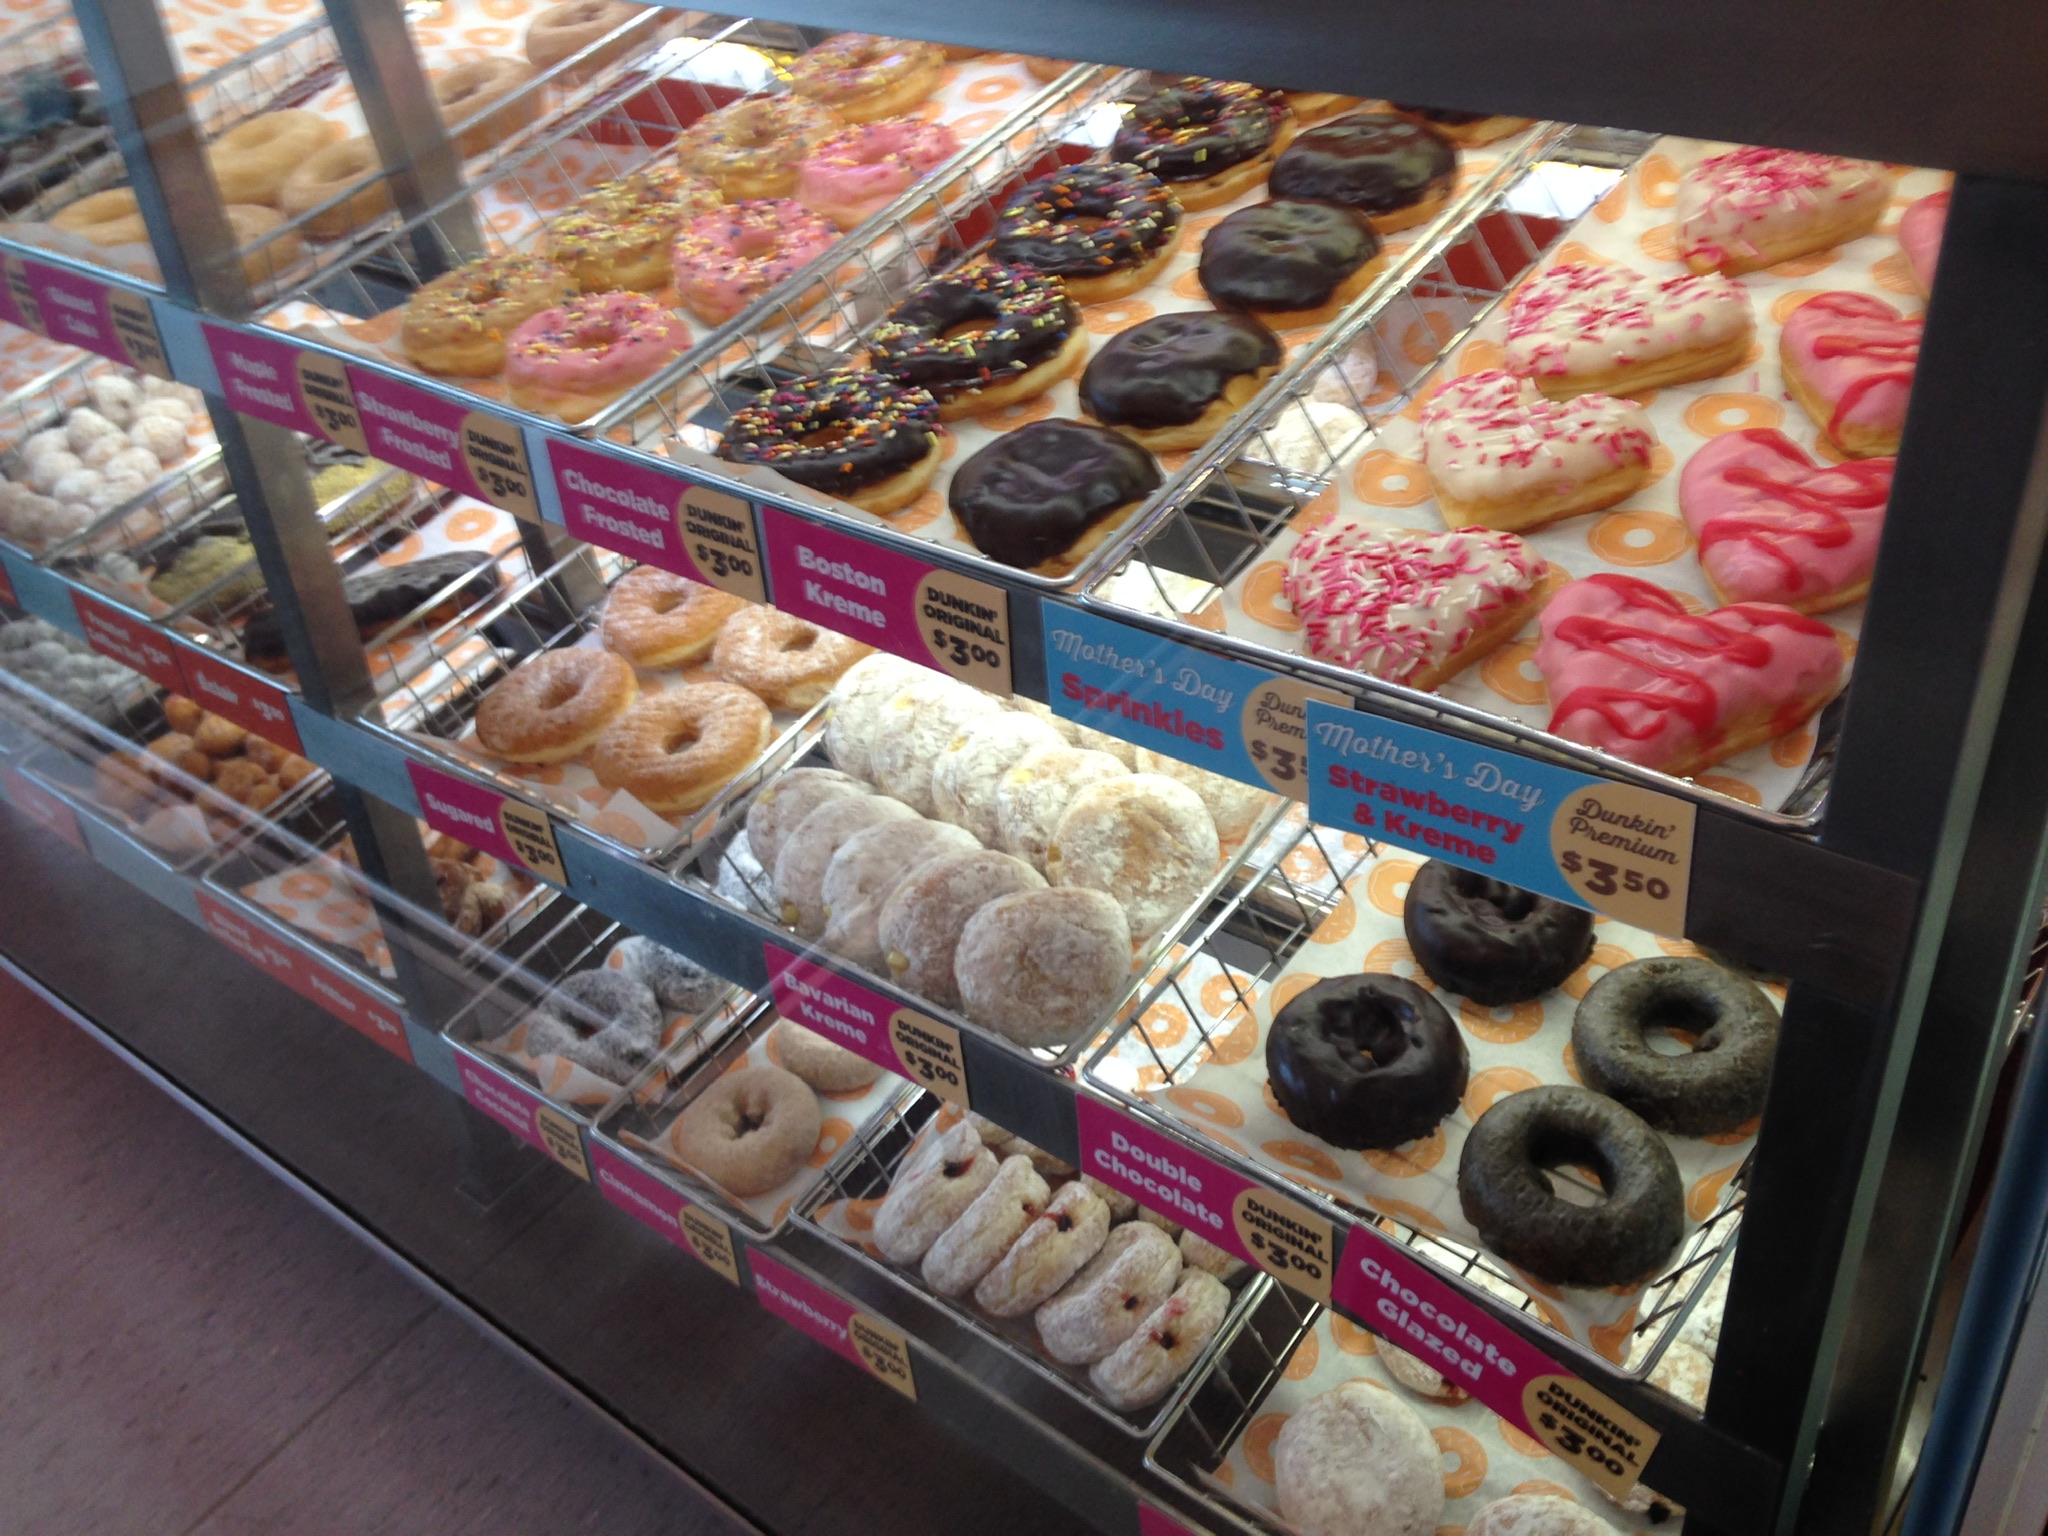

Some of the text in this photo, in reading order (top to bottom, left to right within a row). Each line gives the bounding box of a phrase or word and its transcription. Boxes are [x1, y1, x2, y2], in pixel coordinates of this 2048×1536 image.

[357, 391, 459, 449] Strawberry
[381, 426, 452, 470] Frosted
[468, 445, 527, 475] ORIGINAL
[563, 469, 670, 521] Chocolate
[687, 504, 745, 533] DUNKIN'
[581, 504, 665, 549] Frosted
[686, 521, 754, 553] ORIGINAL
[798, 545, 887, 596] Boston
[805, 580, 886, 628] Kreme
[924, 605, 1005, 645] ORIGINAL
[927, 587, 998, 622] DUNKIN'
[1052, 629, 1234, 713] Mother's Day
[1061, 672, 1225, 750] Sprinkles
[1256, 708, 1307, 739] Prem
[1314, 721, 1545, 812] Mother's Day
[425, 792, 496, 834] Sugared
[1328, 764, 1526, 845] Strawberry
[1576, 797, 1675, 840] Dunkin'
[1352, 802, 1497, 865] & Kreme
[1570, 817, 1679, 866] Premium
[783, 971, 876, 1026] Bavarian
[800, 1001, 867, 1044] Kreme
[896, 1031, 962, 1070] ORIGINAL
[1111, 1131, 1203, 1192] Double
[600, 1168, 678, 1228] Cinnamon
[1094, 1149, 1224, 1230] Chocolate
[1242, 1210, 1329, 1264] ORIGINAL
[1247, 1197, 1323, 1244] DUNKIN'
[755, 1273, 847, 1340] Strawberry
[1359, 1257, 1517, 1376] Chocolate
[1376, 1297, 1484, 1382] Glazed
[1536, 1390, 1640, 1467] ORIGINAL
[1548, 1382, 1642, 1447] DUNKIN'
